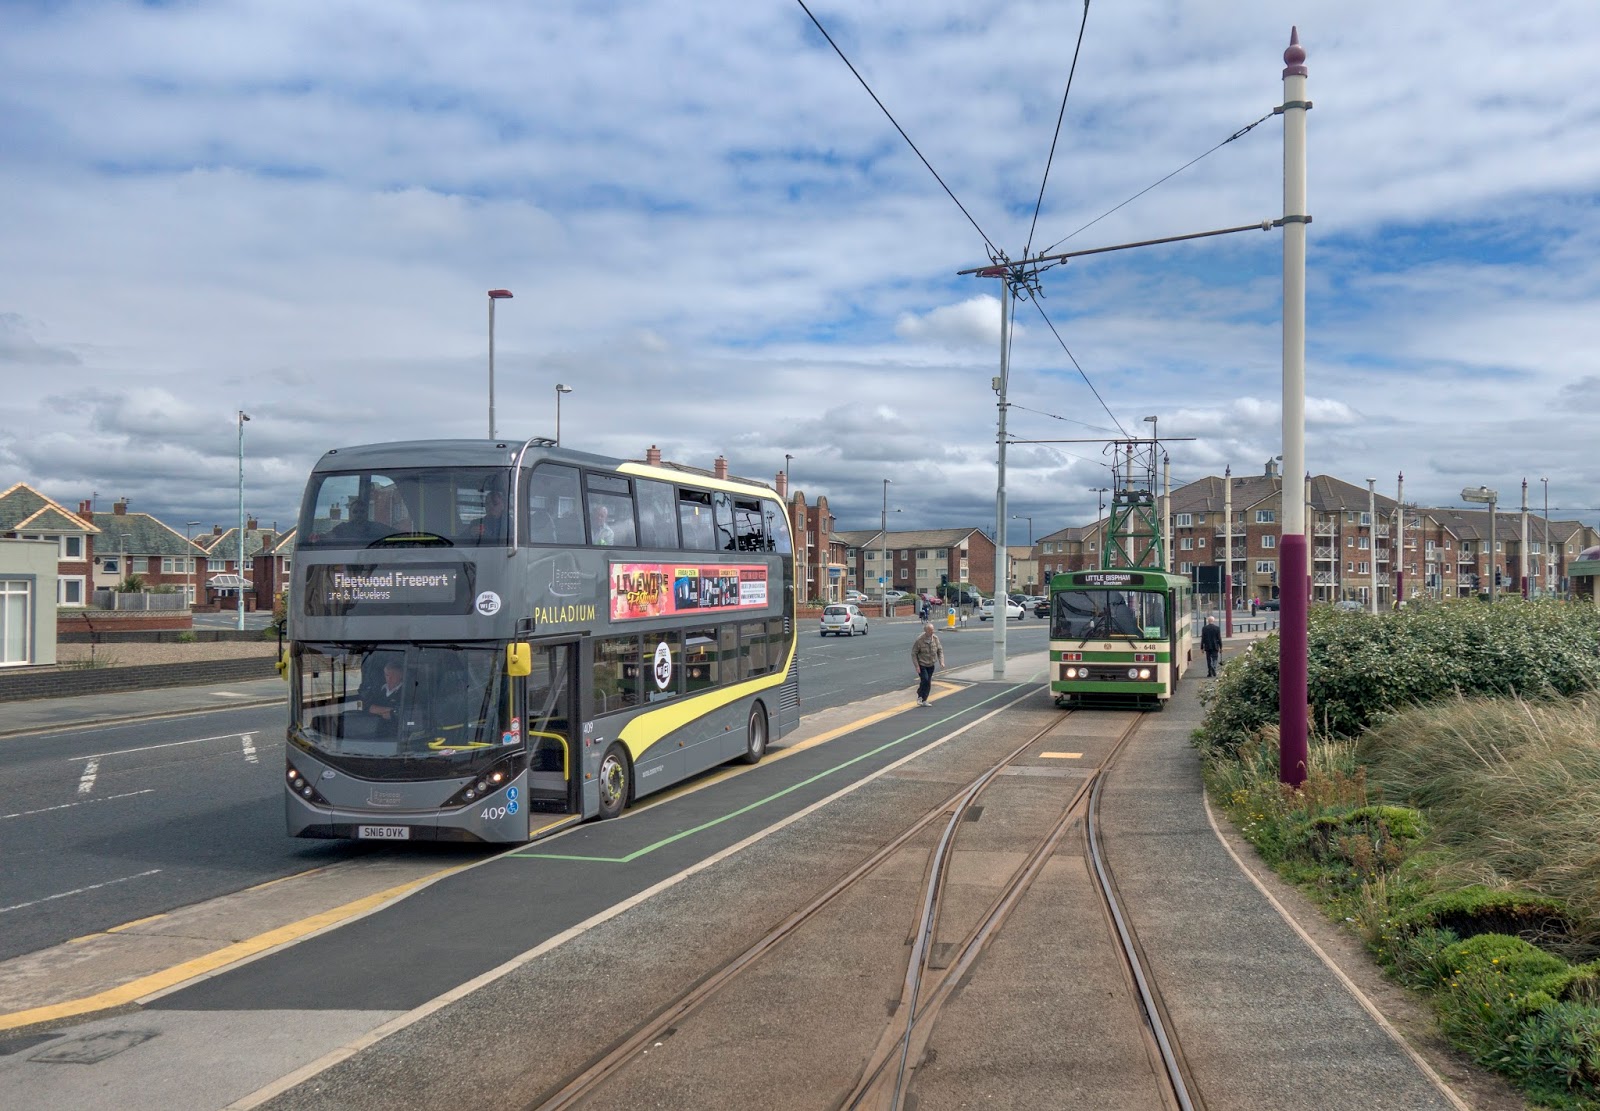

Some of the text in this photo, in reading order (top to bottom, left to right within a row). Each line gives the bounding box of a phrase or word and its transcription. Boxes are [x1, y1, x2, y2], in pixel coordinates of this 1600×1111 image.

[334, 572, 448, 588] Fleetwood Freeport
[617, 572, 669, 595] LIVEWIRE
[352, 588, 391, 601] Cleveleys
[627, 590, 659, 607] Festival
[535, 604, 595, 625] PALLADIUM
[582, 721, 594, 734] 409
[480, 806, 506, 820] 409
[364, 828, 404, 837] SN16 OVK
